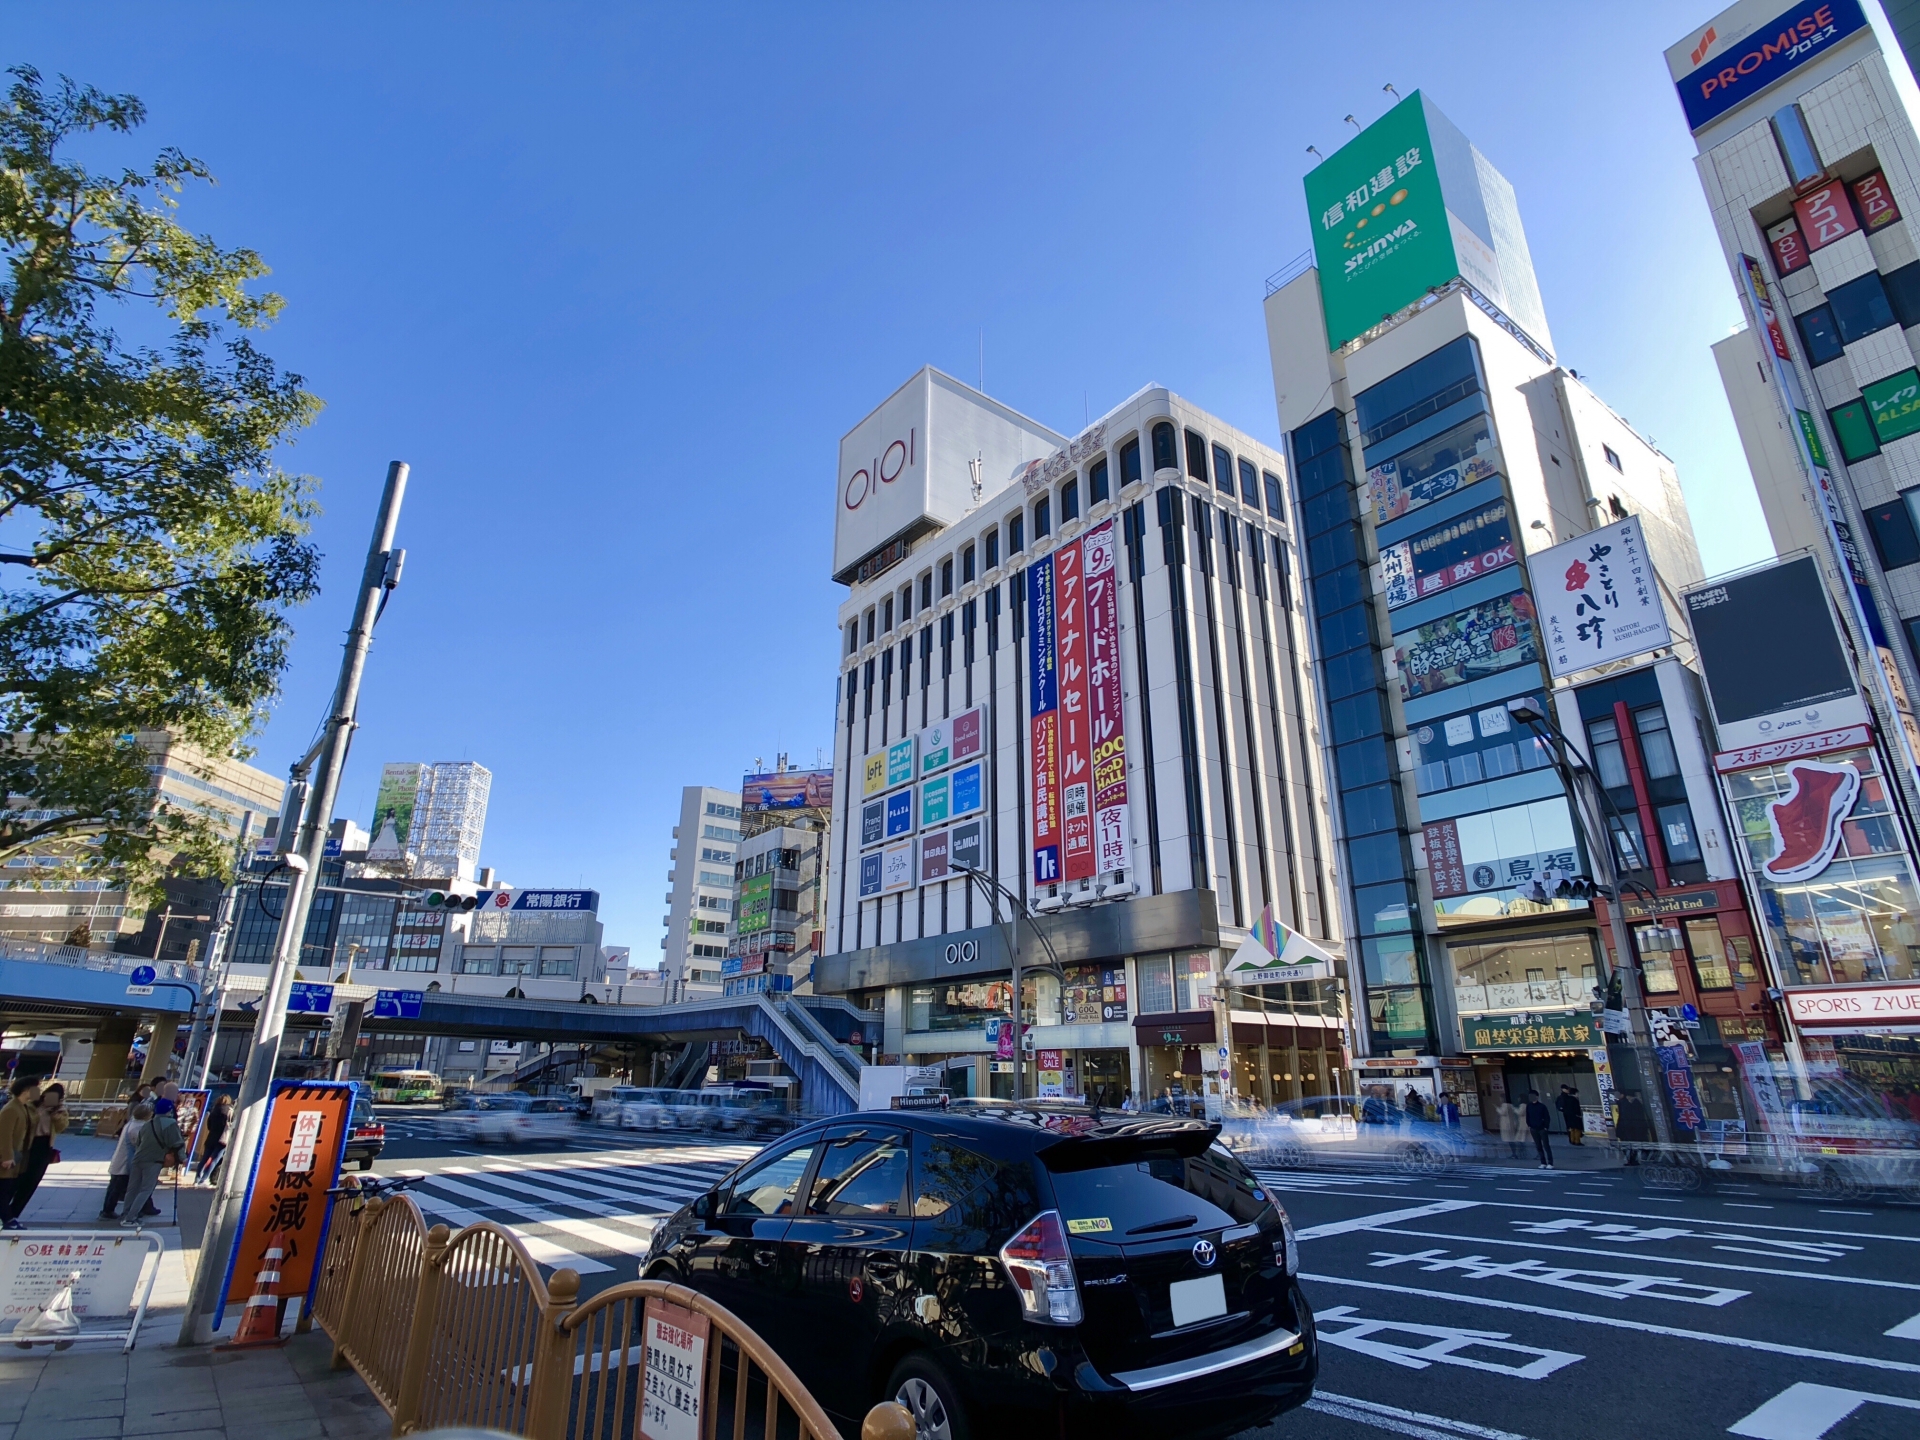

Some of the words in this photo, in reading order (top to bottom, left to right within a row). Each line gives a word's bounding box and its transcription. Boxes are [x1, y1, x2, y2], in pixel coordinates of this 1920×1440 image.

[1701, 4, 1835, 99] PROMISE
[1785, 24, 1838, 60] プロミス
[1322, 147, 1422, 230] 信和建設
[1857, 175, 1889, 215] アコム
[1805, 189, 1845, 243] アコム
[1778, 237, 1799, 269] 8F
[1871, 385, 1918, 411] レイク
[1087, 534, 1112, 548] レストラン
[1092, 547, 1111, 572] 9F
[1620, 526, 1650, 606] 昭和五十四年創業
[1383, 549, 1408, 605] 九州酒場
[1588, 543, 1619, 608] やきとり
[1036, 566, 1047, 711] スタープログラミングスクール
[1612, 621, 1640, 634] YAKITORI
[1614, 622, 1661, 642] KUSHI-HACCHIN
[1549, 615, 1568, 665] 炭火焼一筋
[1060, 550, 1086, 780] ファイナルセール
[1088, 578, 1115, 744] フードホール
[954, 734, 966, 744] Food
[966, 729, 978, 739] select
[890, 744, 911, 766] ニトリ
[962, 746, 970, 755] B1
[1732, 733, 1851, 765] スポーツジュエン
[1036, 717, 1049, 837] パソコン市民講座
[889, 805, 909, 818] PLAZA
[895, 824, 902, 832] 4F
[1067, 820, 1088, 834] ネット
[924, 845, 947, 859] 無印良品
[962, 834, 979, 848] MUJI
[1067, 835, 1089, 851] 通販
[887, 862, 908, 874] コンタクト
[1037, 849, 1055, 880] 7F
[1426, 827, 1449, 893] 鉄板焼き餃子
[526, 893, 582, 908] 常陽銀行
[1682, 898, 1704, 909] End
[1252, 969, 1304, 981] 上野御徒町中央通り
[1797, 997, 1862, 1014] SPORTS
[1724, 1028, 1744, 1036] Irish
[1746, 1027, 1764, 1035] Pub
[1041, 1051, 1059, 1060] FINAL
[1043, 1059, 1060, 1068] SALE
[899, 1097, 940, 1106] Hinomaru
[1667, 1069, 1701, 1130] 国産牛
[290, 1114, 317, 1169] 休工中
[39, 1244, 106, 1256] 駐輪禁止
